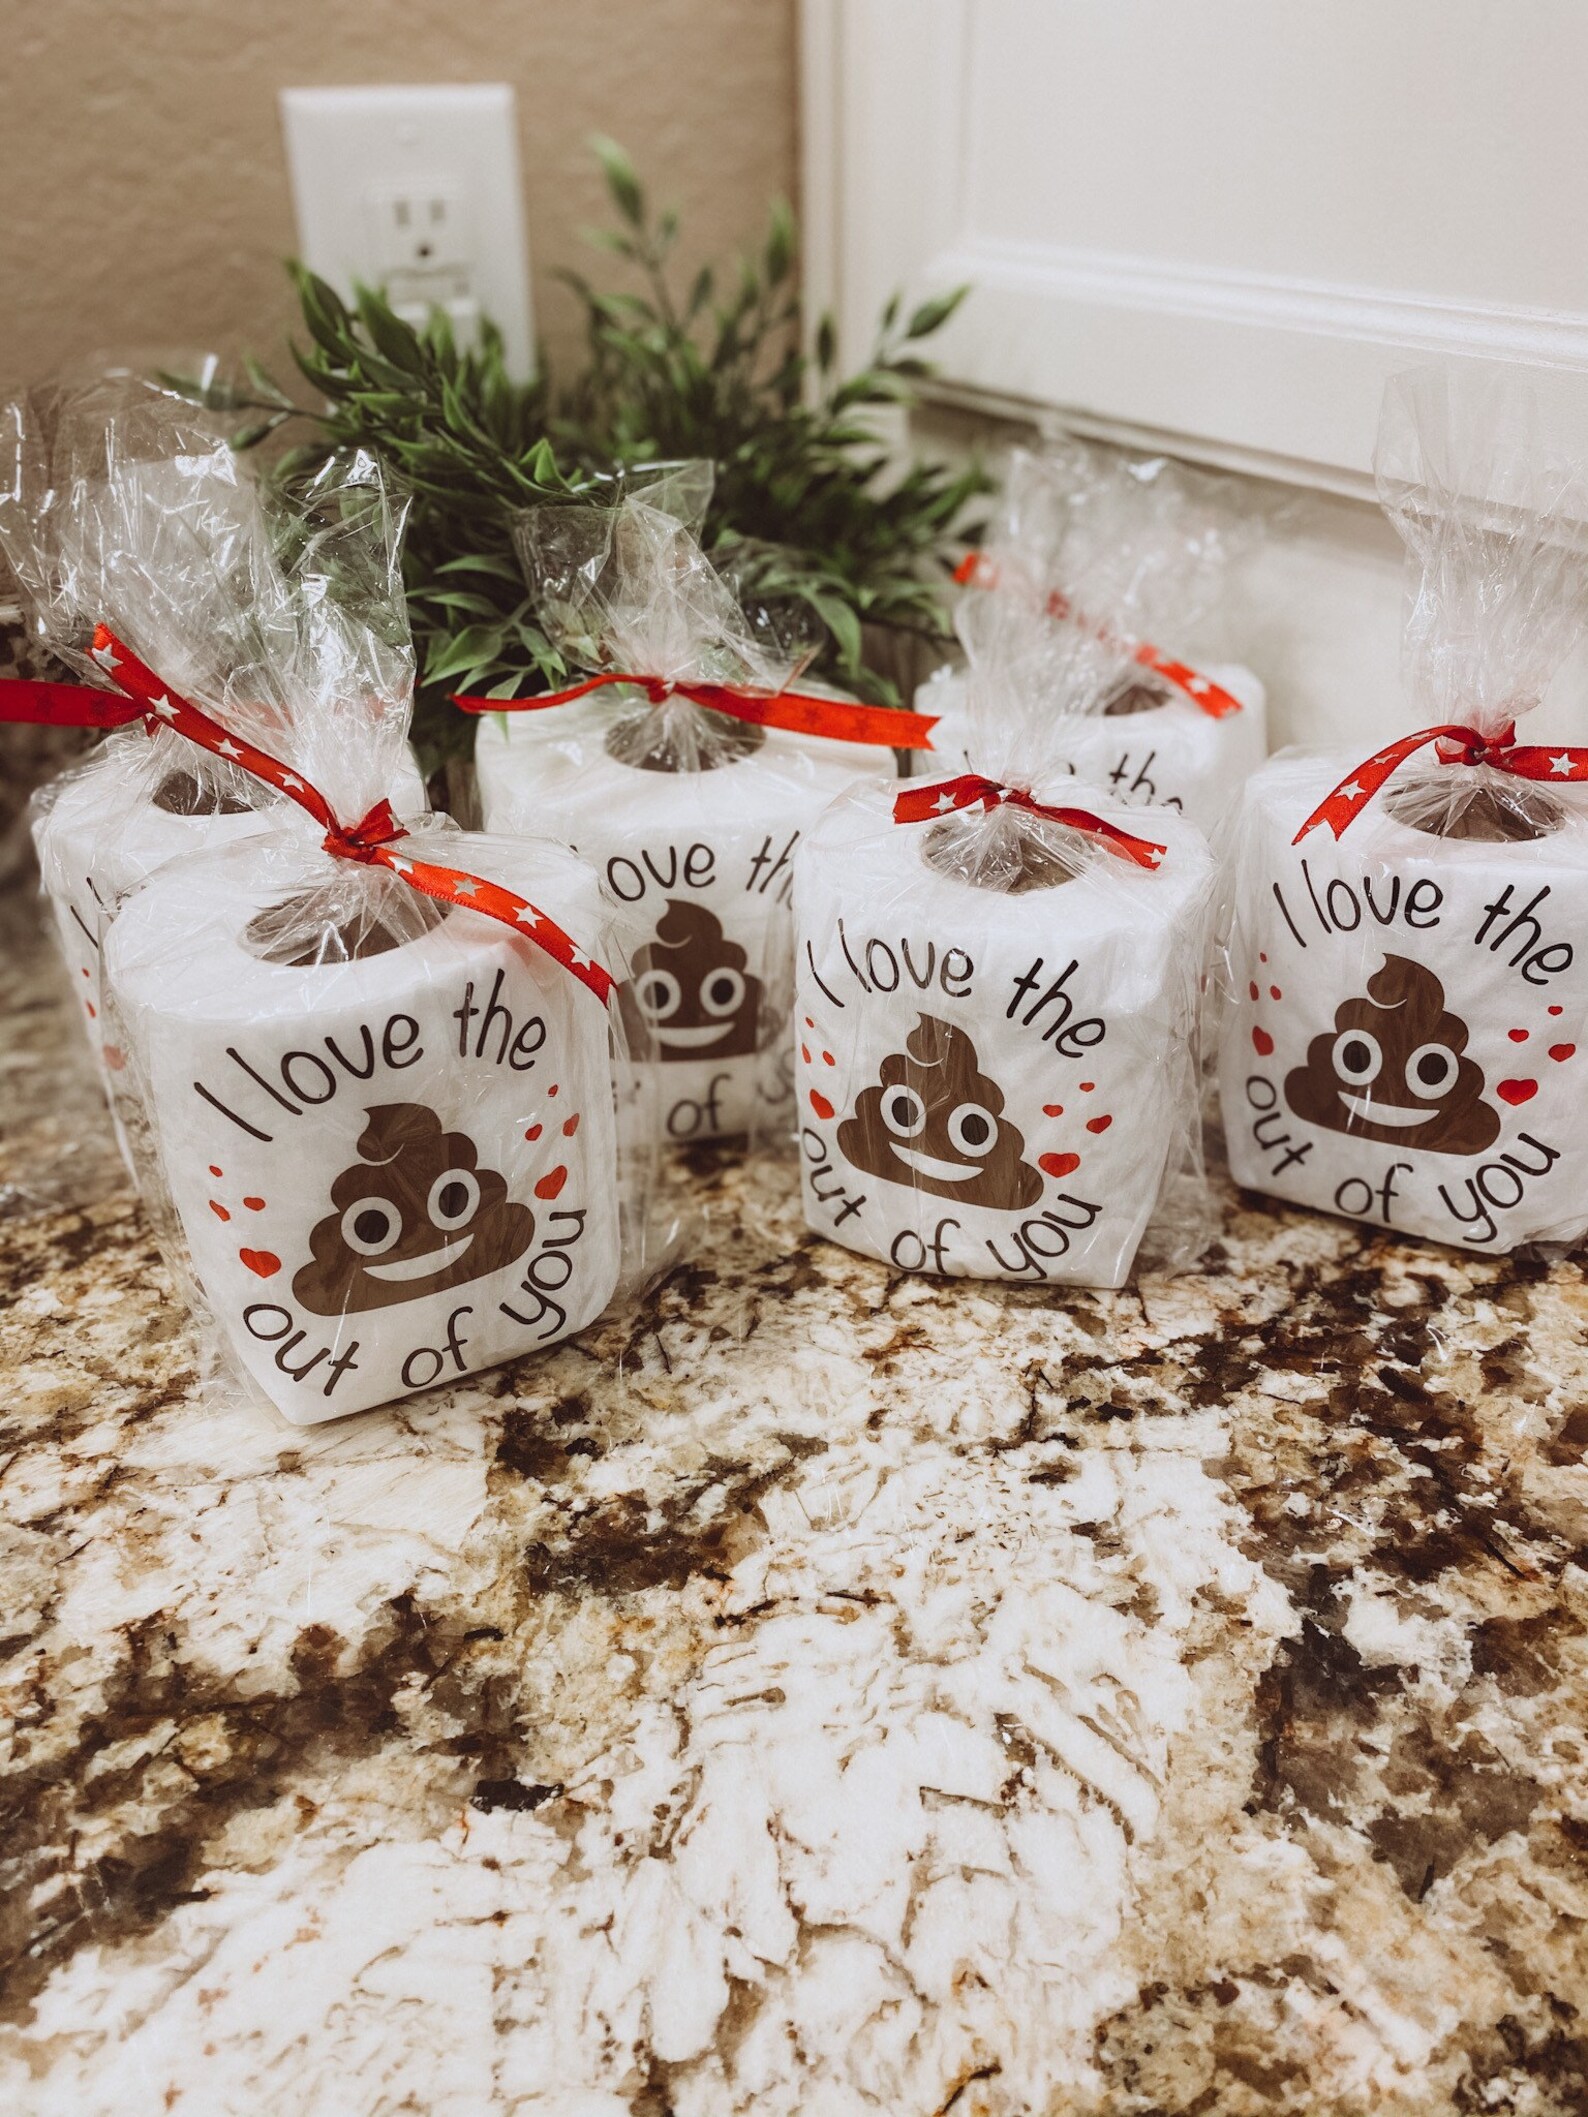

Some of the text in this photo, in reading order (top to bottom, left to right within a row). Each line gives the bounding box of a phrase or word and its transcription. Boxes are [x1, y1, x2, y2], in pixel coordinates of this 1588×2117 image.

[600, 842, 717, 903] ove
[1273, 859, 1574, 985] I love the
[452, 968, 547, 1072] the
[807, 918, 1106, 1059] I love the
[194, 1082, 273, 1142] I
[226, 1013, 423, 1116] love
[666, 1073, 731, 1137] of
[802, 1127, 1104, 1281] out of you
[1245, 1075, 1562, 1244] out of you
[242, 1208, 587, 1396] out of you
